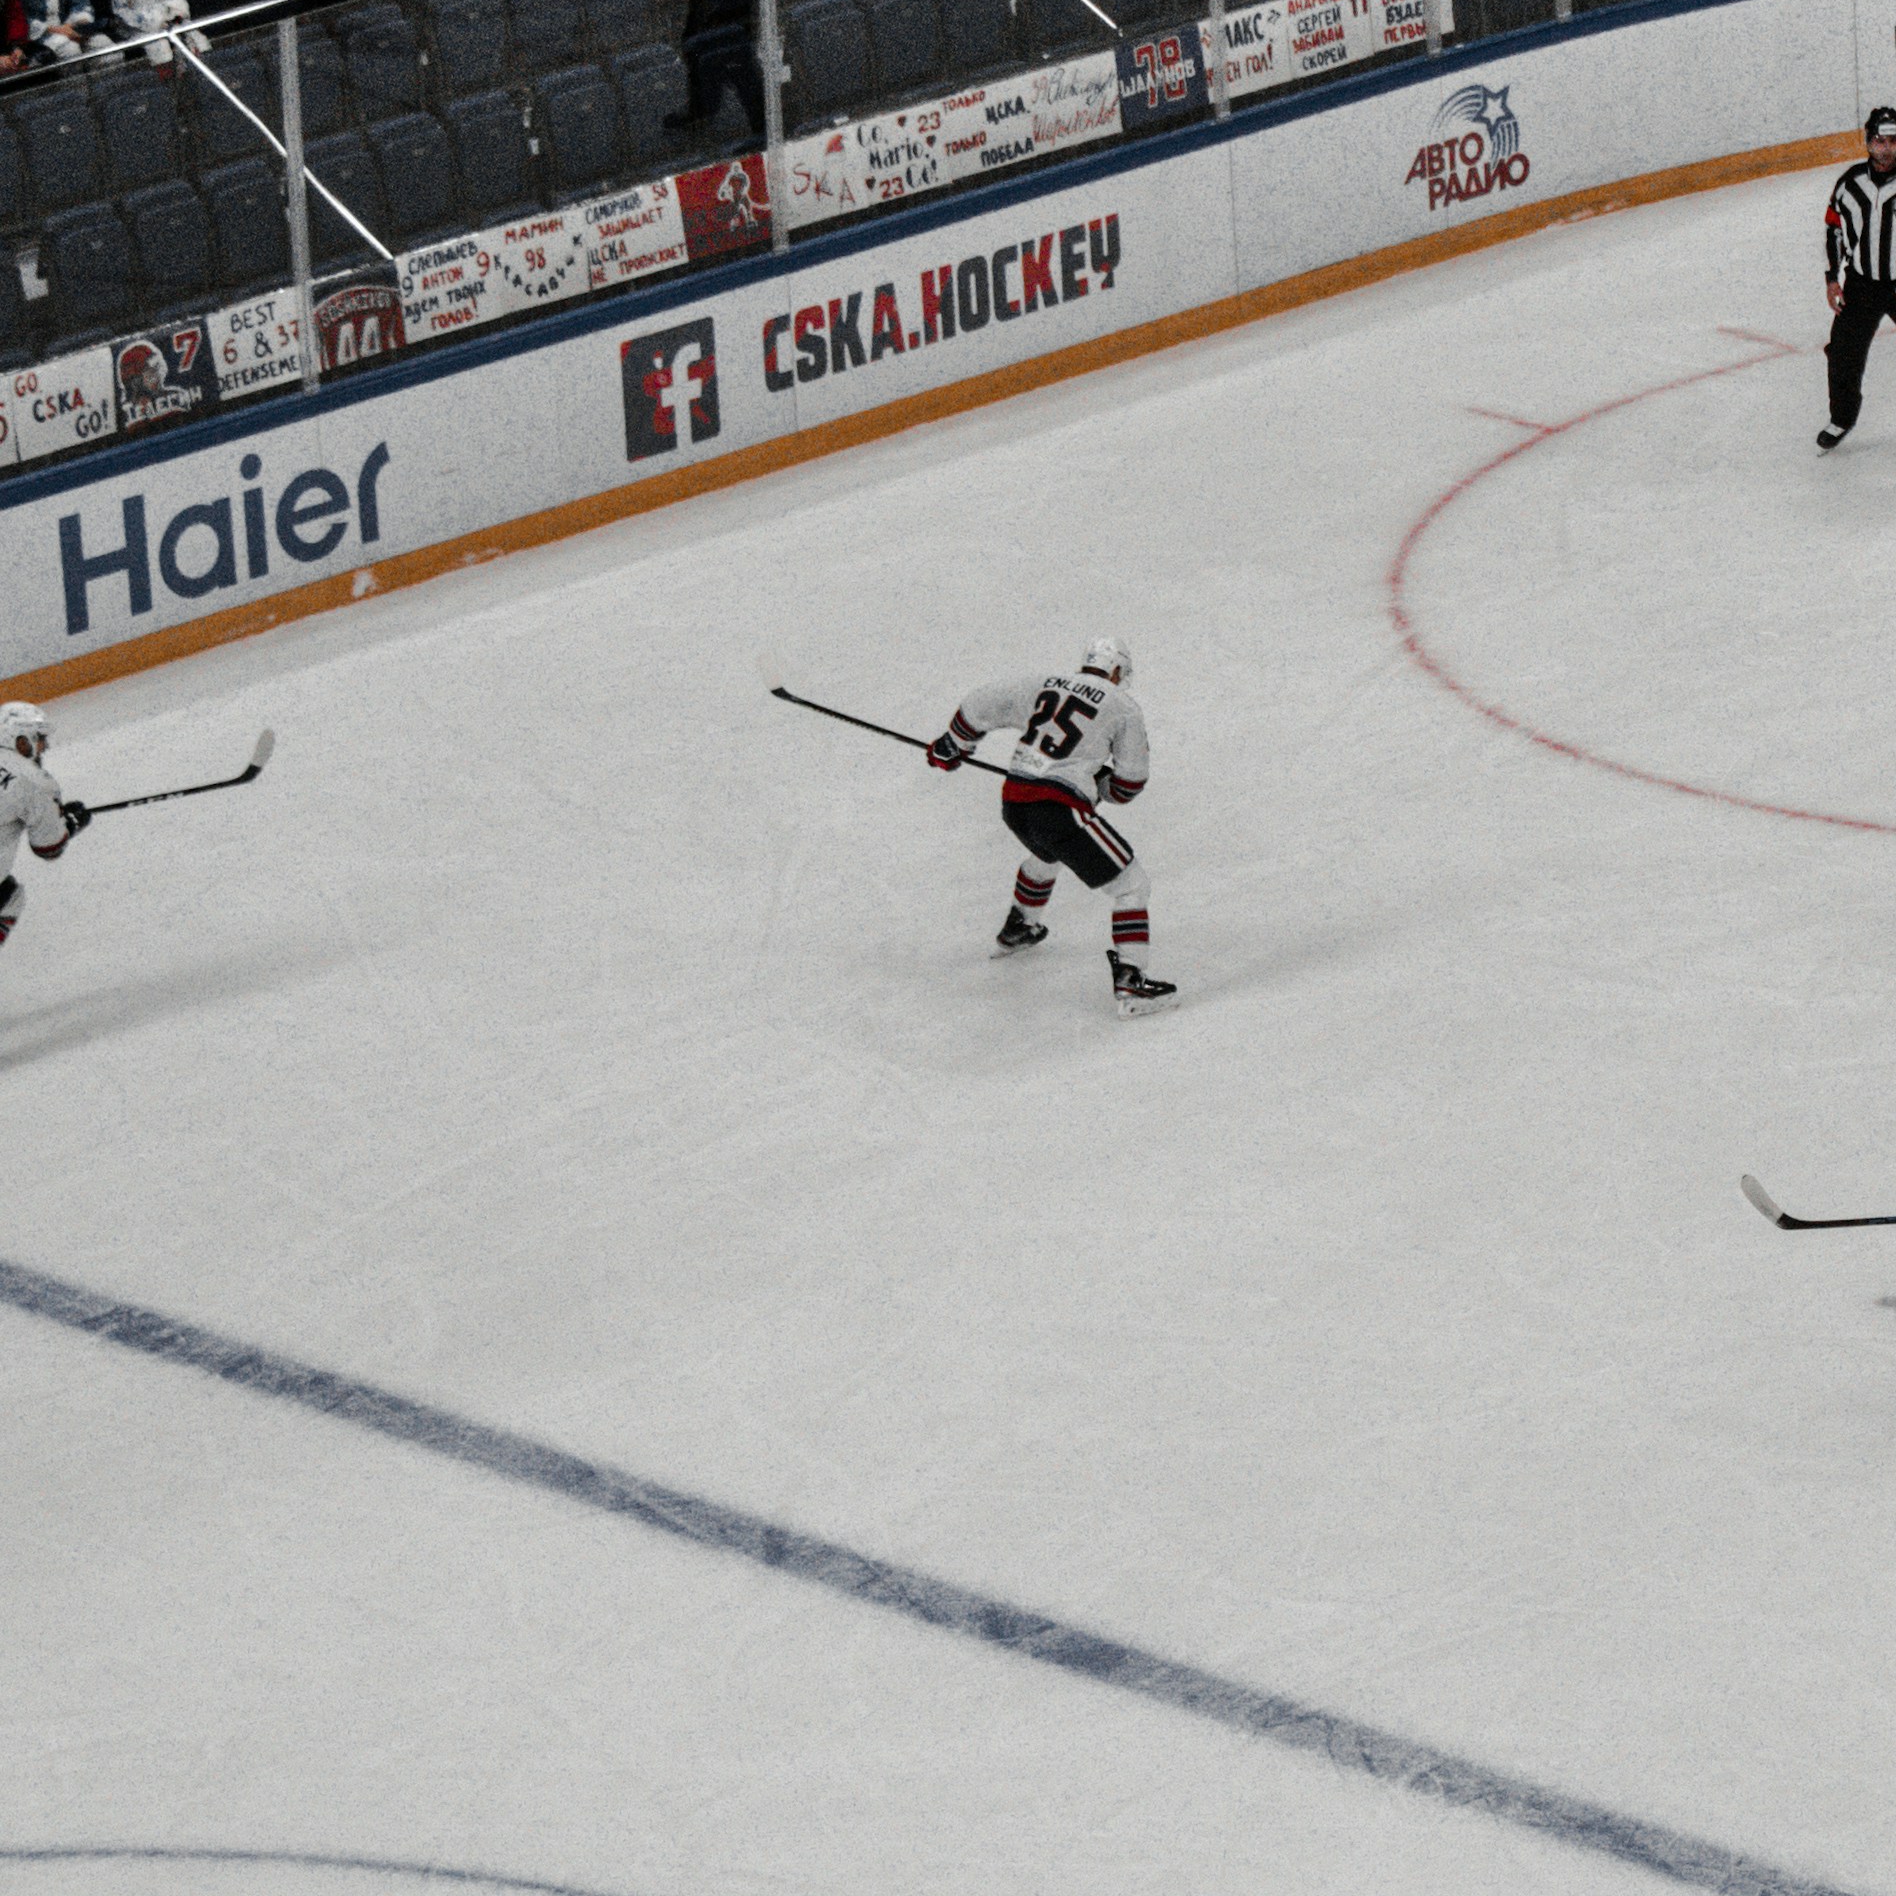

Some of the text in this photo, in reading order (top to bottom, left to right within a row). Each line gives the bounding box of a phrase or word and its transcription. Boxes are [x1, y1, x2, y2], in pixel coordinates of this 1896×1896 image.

[1296, 4, 1343, 34] СЕРГЕЙ
[1385, 0, 1424, 26] БУДЕ
[1383, 19, 1427, 45] ПЕРВЫ
[1301, 44, 1348, 72] СКОРЕЙ
[942, 90, 987, 114] ТОЛЬКО
[917, 110, 942, 134] 23
[944, 130, 987, 156] ТОЛЬКО
[980, 137, 1034, 168] ПОБЕДА
[1404, 131, 1485, 186] АВТО
[879, 176, 905, 200] 23
[1428, 151, 1531, 213] РАДИО
[504, 217, 565, 246] МАМИН
[524, 246, 547, 272] 98
[588, 239, 629, 267] ЦСКА
[421, 266, 465, 292] АНТОН
[229, 300, 278, 335] BEST
[760, 212, 1122, 394] CSKA.HOCKEY
[171, 325, 203, 373] 7
[216, 354, 300, 394] DEFENSEME
[57, 440, 391, 636] Haier
[1043, 676, 1107, 706] ENLUND
[1020, 689, 1099, 761] 25
